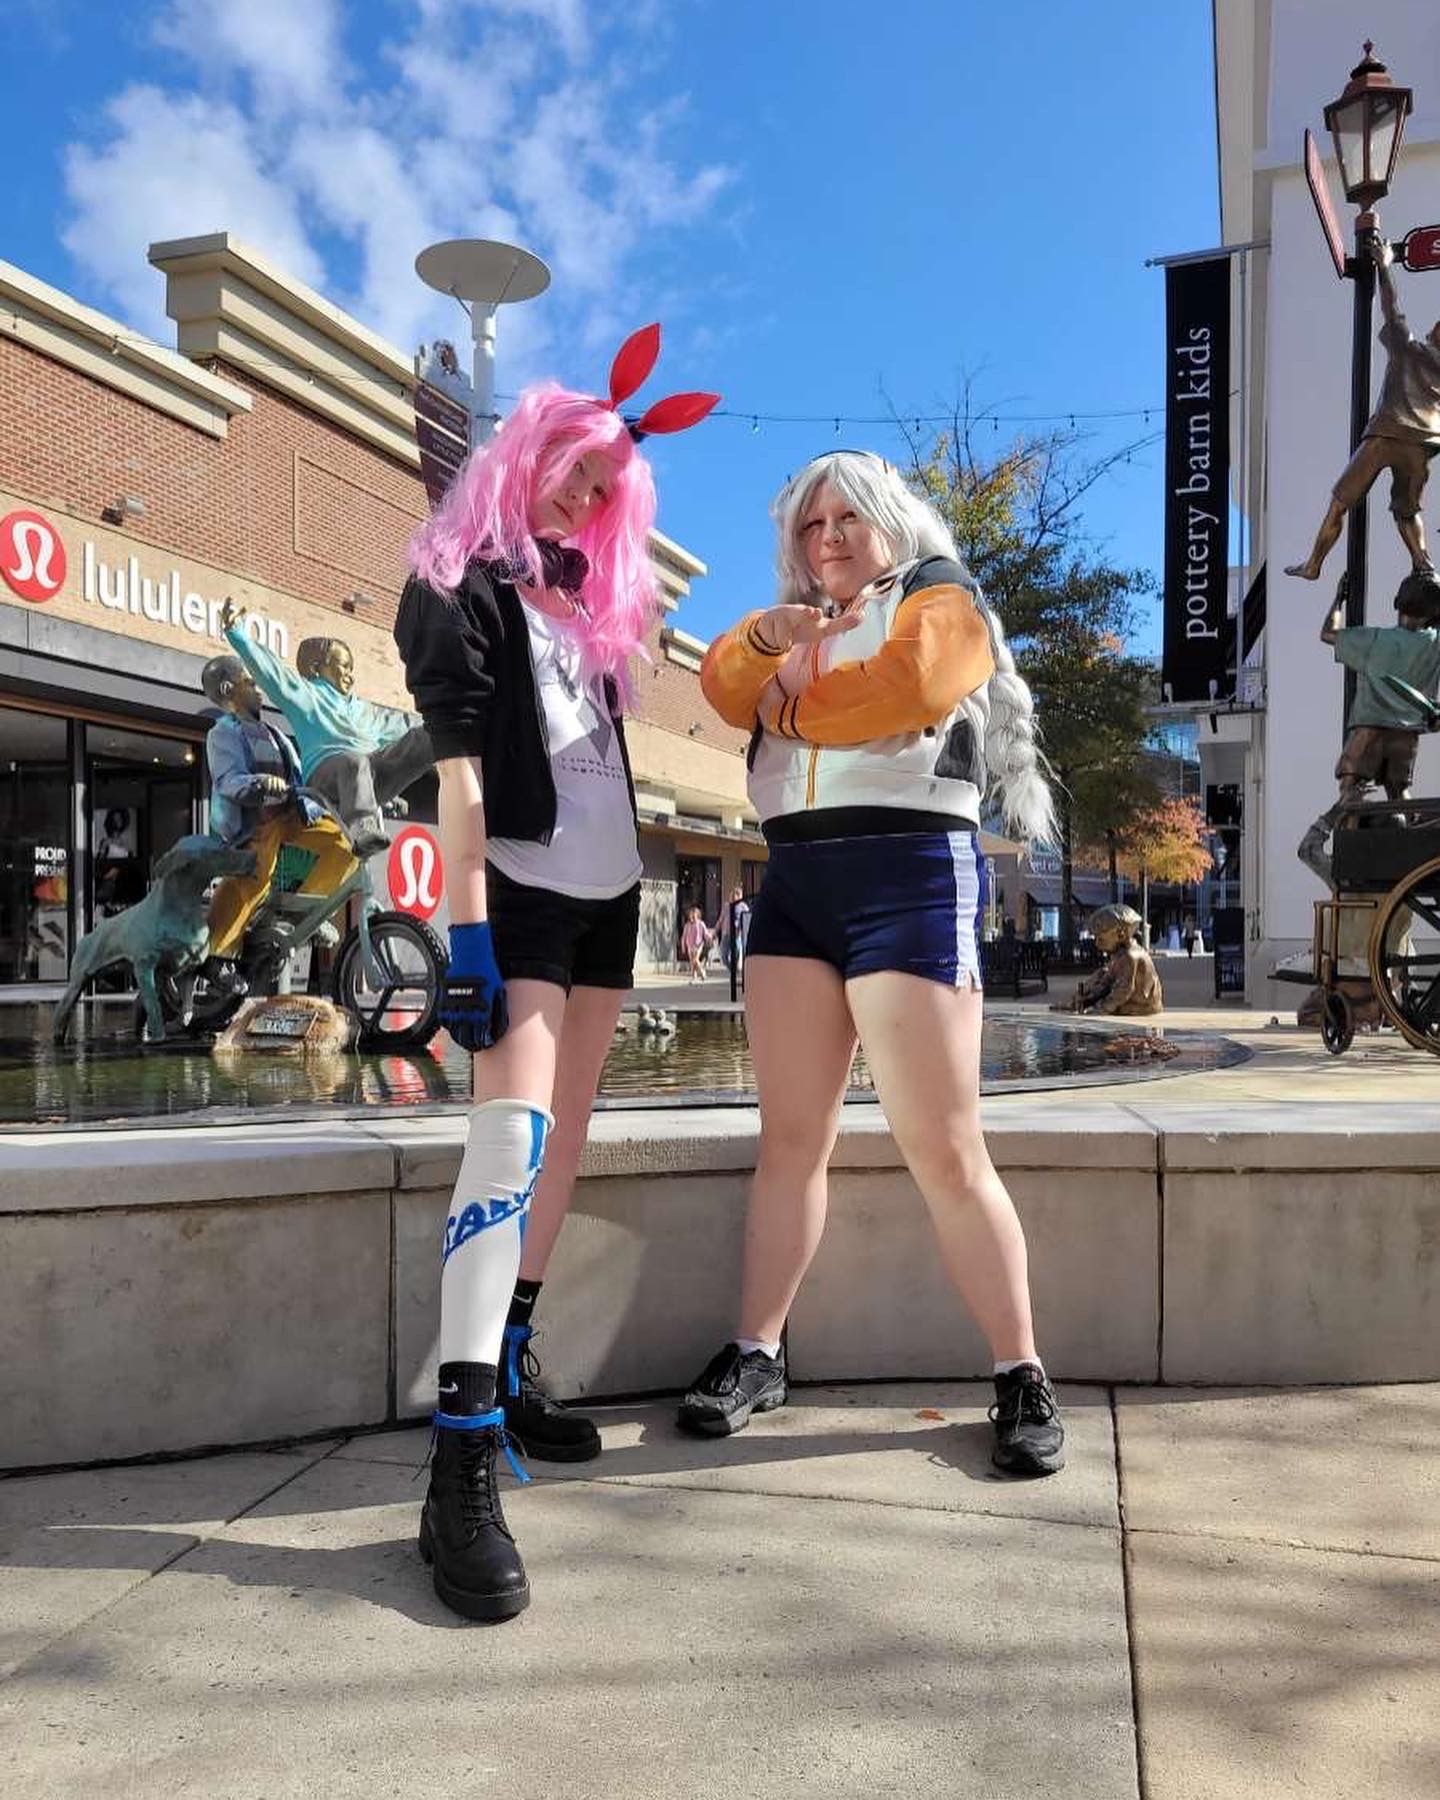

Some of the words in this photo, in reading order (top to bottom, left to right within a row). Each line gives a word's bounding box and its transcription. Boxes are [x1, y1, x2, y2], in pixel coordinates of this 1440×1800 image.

[1176, 327, 1210, 400] kids
[1175, 412, 1210, 496] barn
[1186, 505, 1219, 639] pottery
